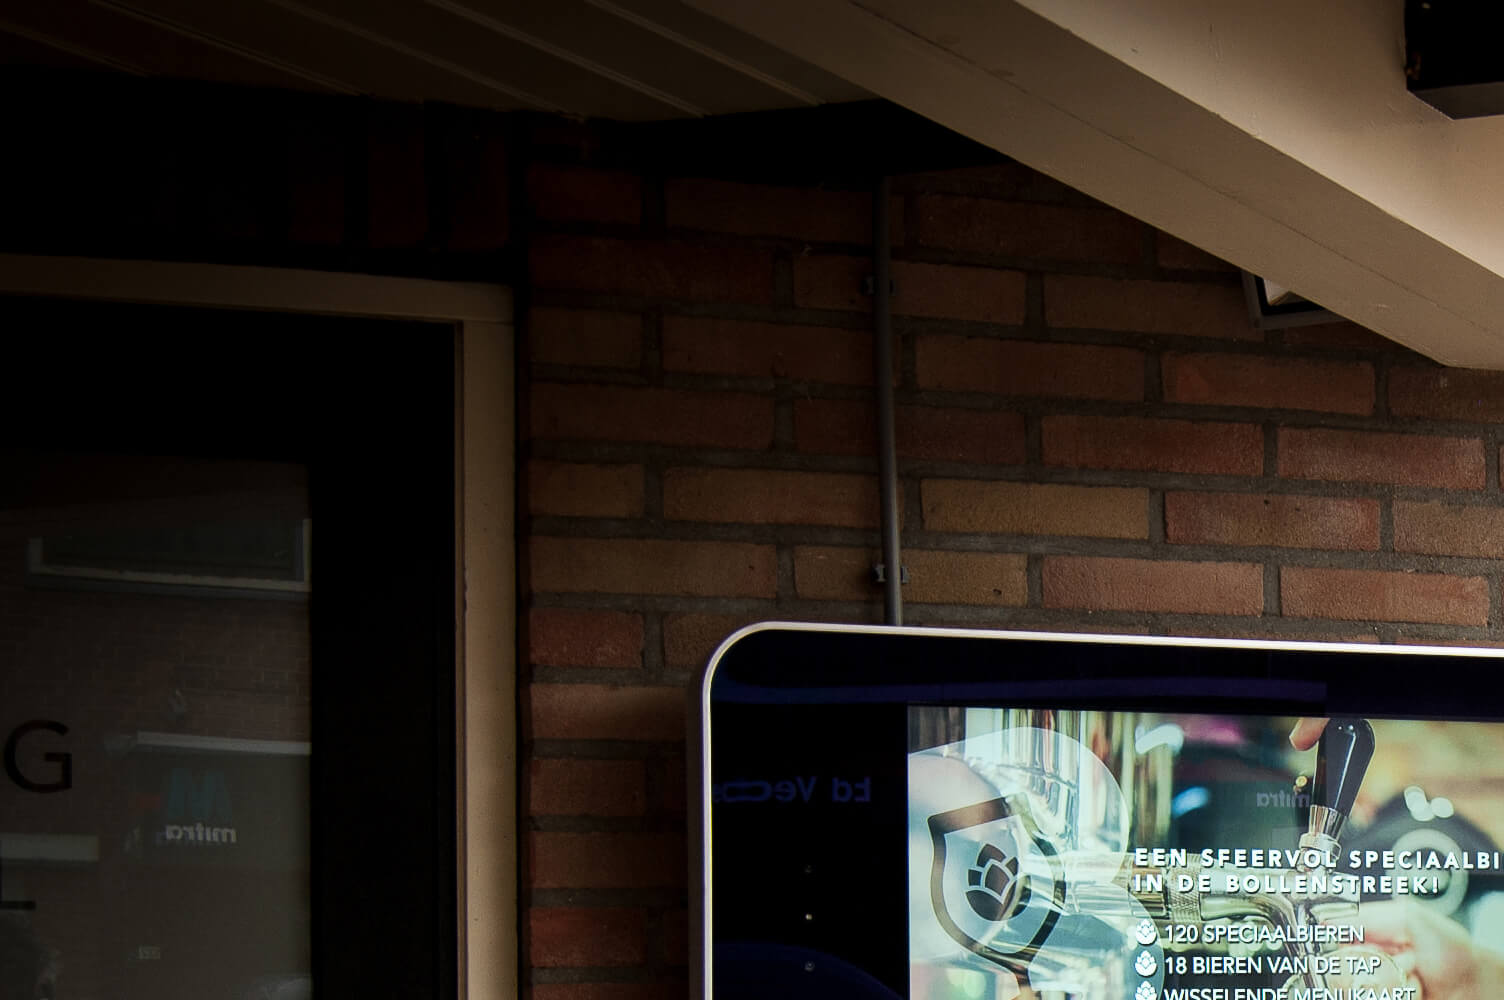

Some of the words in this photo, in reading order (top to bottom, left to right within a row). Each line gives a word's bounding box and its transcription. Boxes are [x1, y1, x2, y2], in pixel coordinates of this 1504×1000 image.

[1134, 847, 1189, 867] EEN
[1200, 848, 1339, 869] SFEERVOL
[1134, 875, 1164, 893] IN
[1178, 875, 1212, 893] DE
[1226, 875, 1440, 895] BOLLENSTREEK!
[1165, 925, 1199, 943] 120
[1203, 925, 1365, 943] SPECIAALBIEREN
[1165, 957, 1188, 975] 18
[1192, 957, 1263, 974] BIEREN
[1266, 957, 1309, 974] VAN
[1315, 957, 1342, 974] DE
[1346, 956, 1382, 974] TAP
